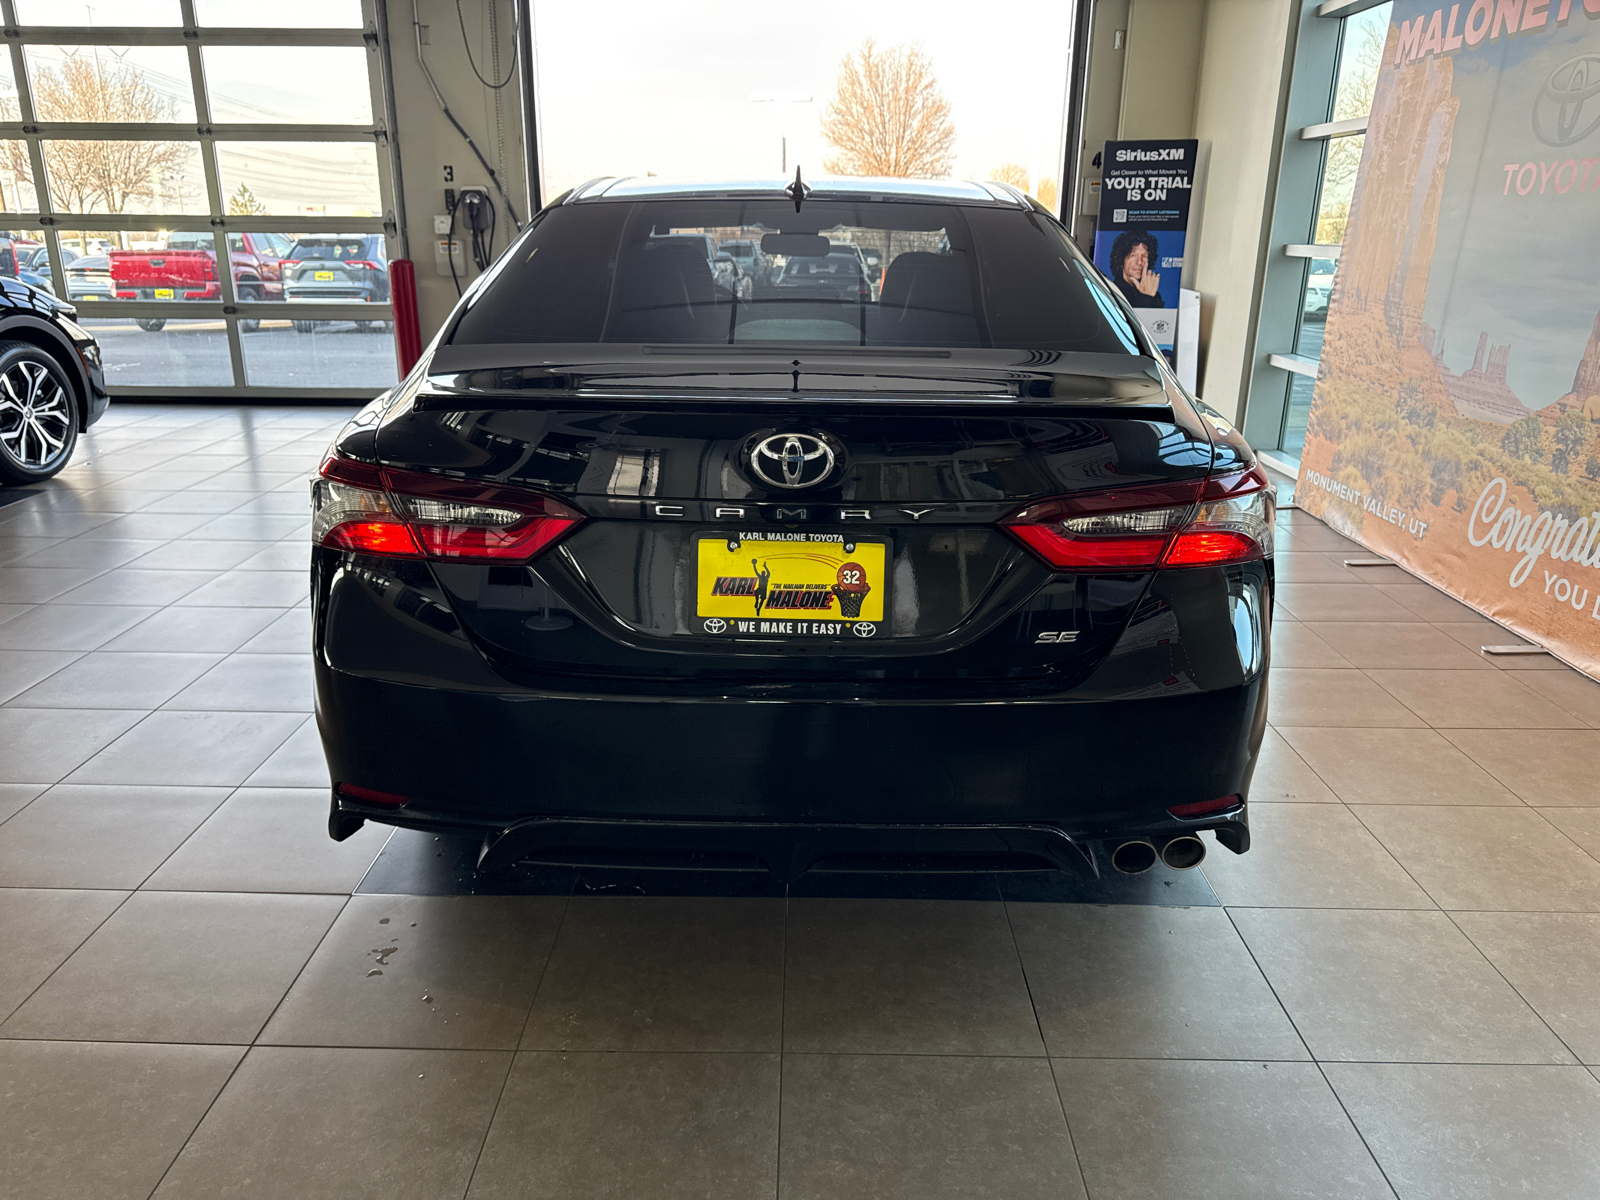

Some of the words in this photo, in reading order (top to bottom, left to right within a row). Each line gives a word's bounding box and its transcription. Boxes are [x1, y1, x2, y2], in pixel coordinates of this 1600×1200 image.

[1115, 148, 1185, 162] SiriusXM
[443, 165, 454, 182] 3
[1104, 177, 1146, 190] YOUR
[1148, 176, 1192, 189] TRIAL
[1126, 189, 1142, 201] IS
[1143, 189, 1167, 201] ON
[1306, 468, 1361, 506] MONUMENT
[1362, 494, 1407, 532] VALLEY,
[1408, 516, 1428, 538] UT
[655, 504, 936, 521] CAMRY
[739, 532, 765, 540] KARL
[767, 532, 806, 541] MALONE
[809, 534, 844, 543] TOYOTA
[842, 570, 861, 585] 32
[712, 577, 758, 596] KARL
[1544, 570, 1588, 610] YOU
[765, 590, 834, 610] MALONE
[738, 621, 756, 633] WE
[760, 621, 793, 634] MAKE
[797, 622, 808, 634] IT
[812, 623, 842, 635] EASY
[1034, 630, 1081, 644] SE
